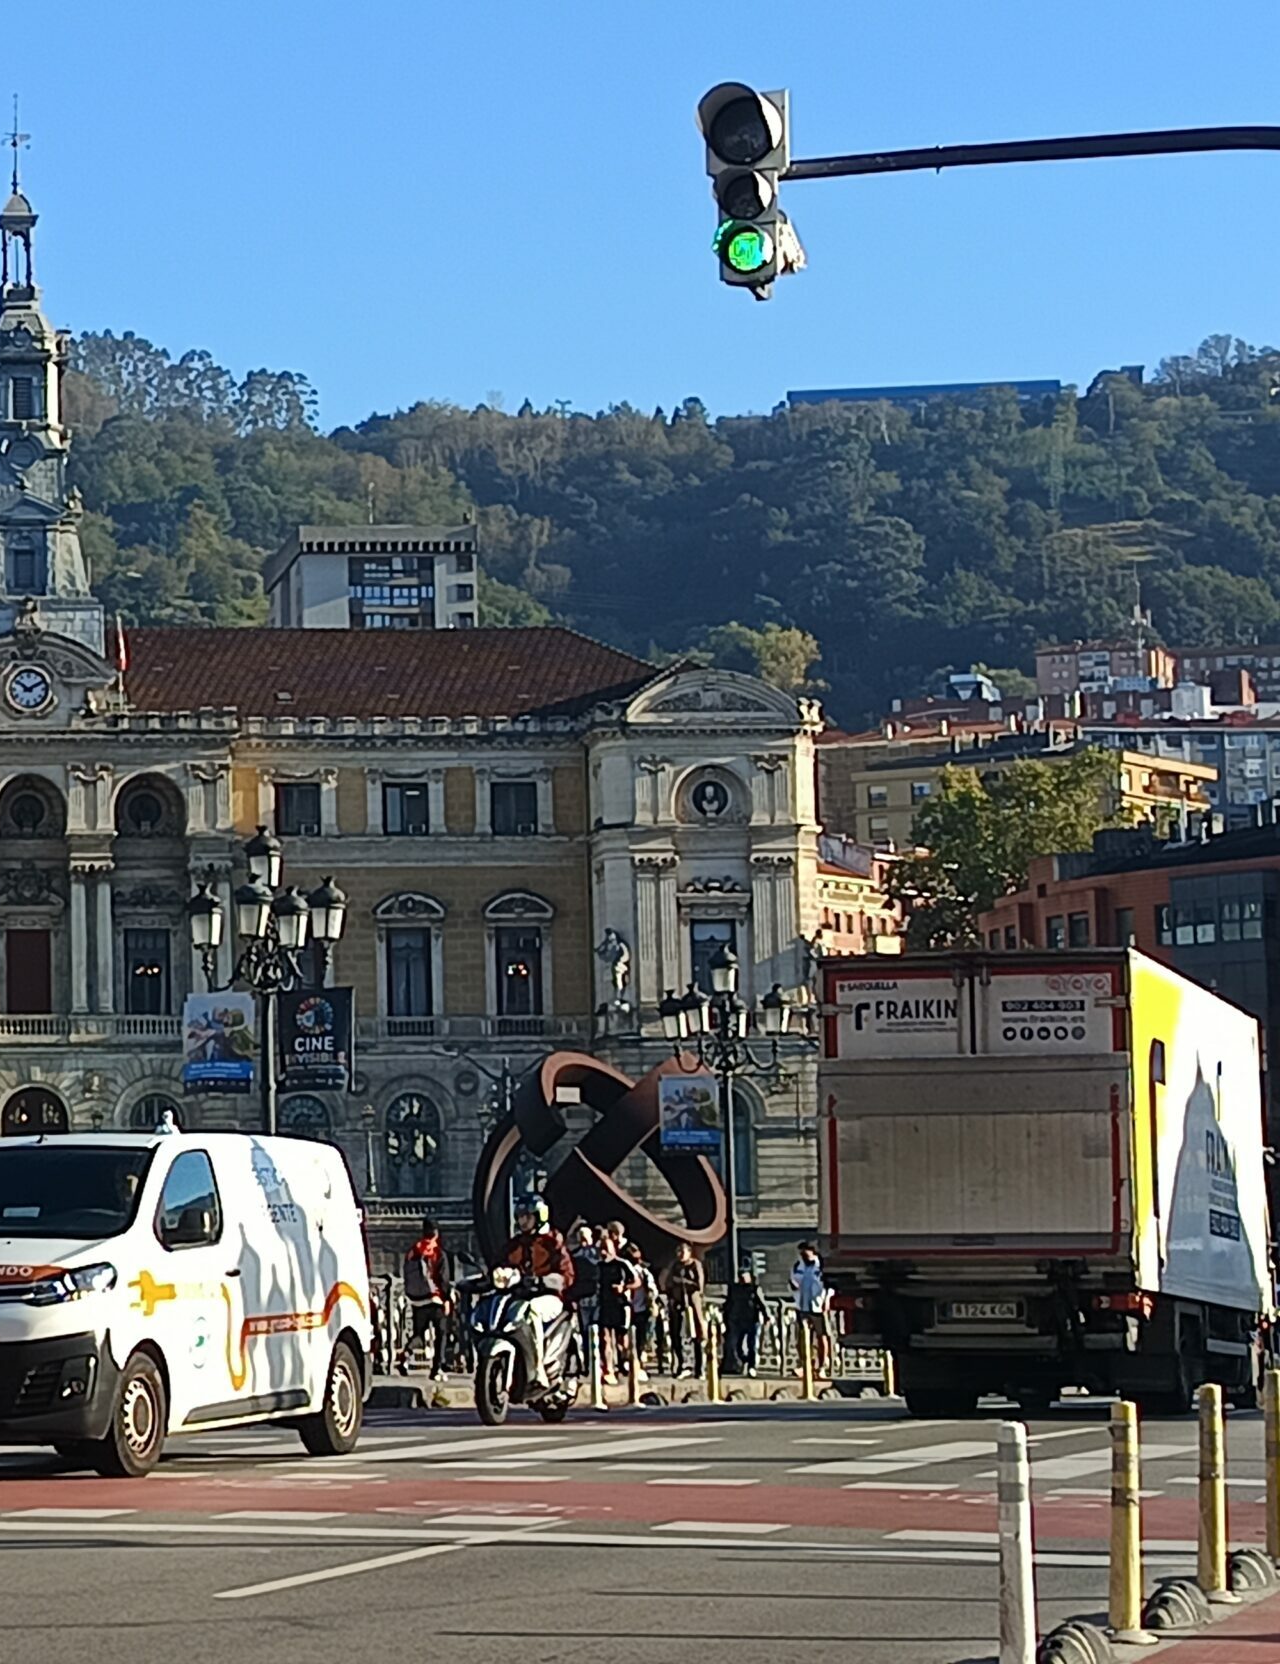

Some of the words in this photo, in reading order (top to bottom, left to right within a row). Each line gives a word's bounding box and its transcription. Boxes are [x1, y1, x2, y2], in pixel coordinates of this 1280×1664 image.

[875, 999, 958, 1020] FRAIKIN
[294, 1036, 335, 1051] CINE
[285, 1051, 347, 1066] INVISIBLE
